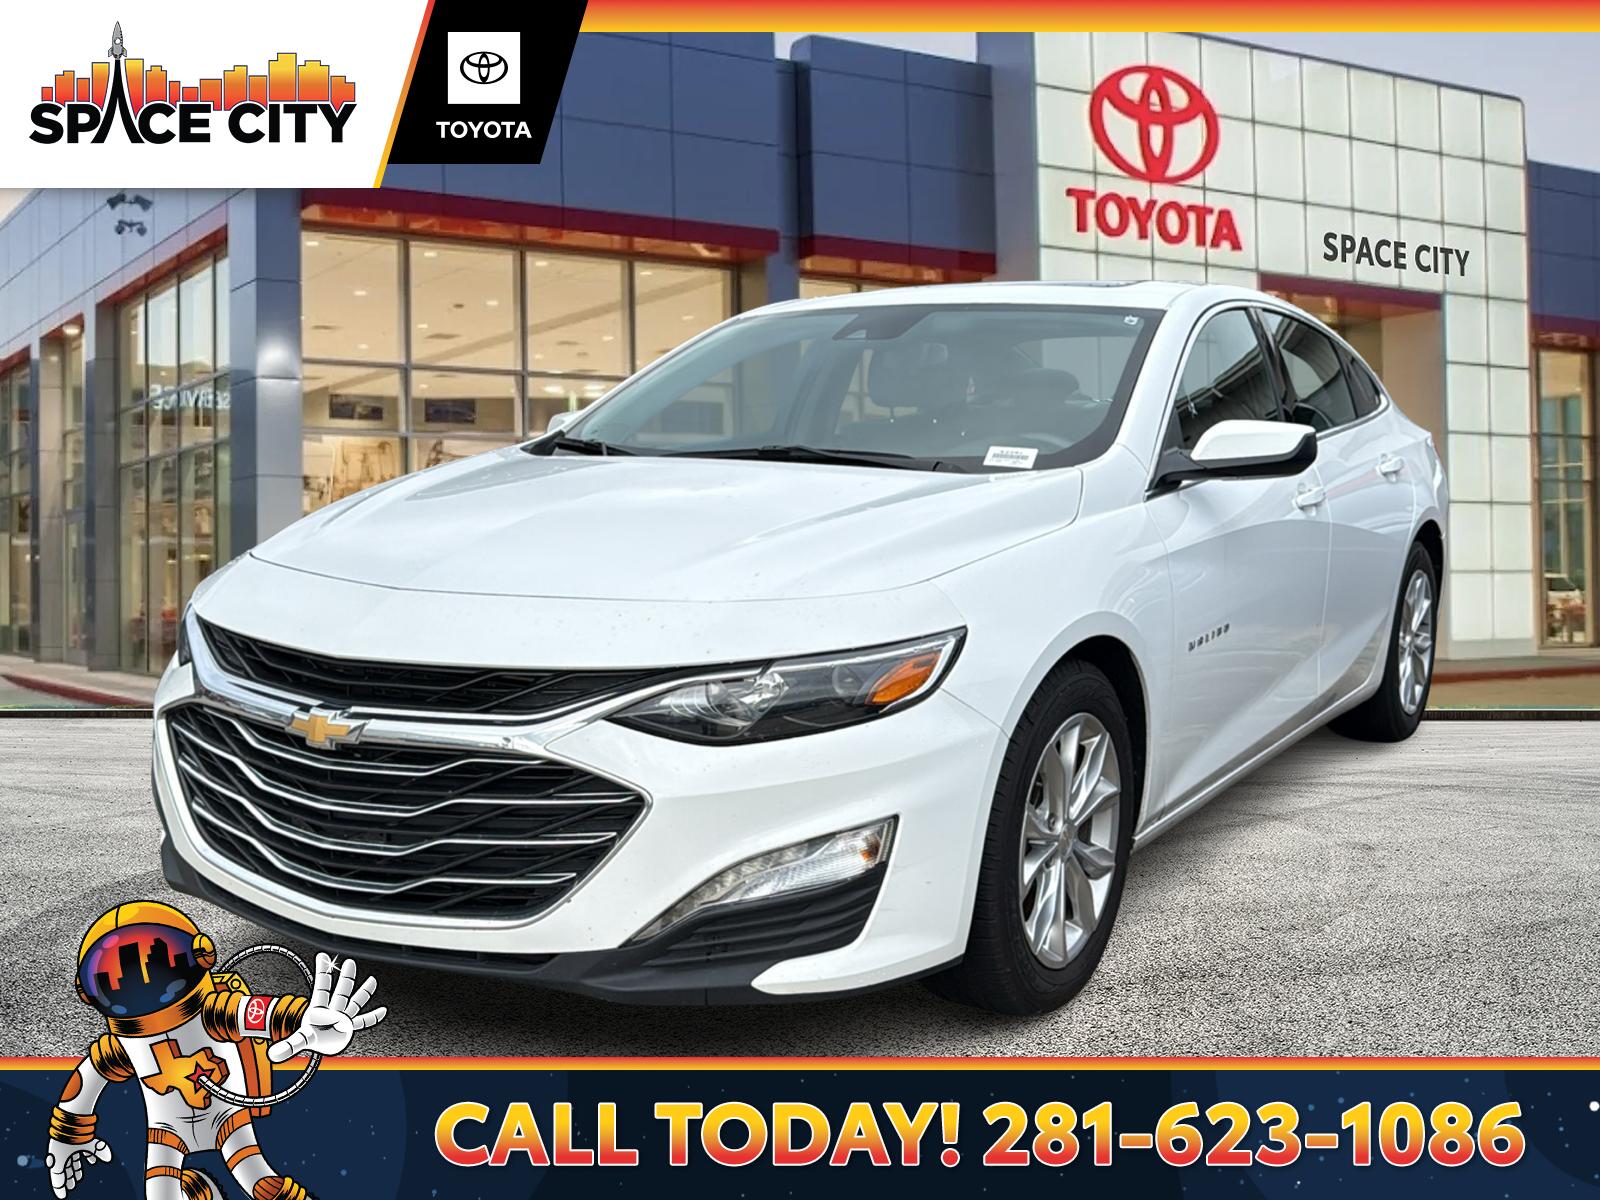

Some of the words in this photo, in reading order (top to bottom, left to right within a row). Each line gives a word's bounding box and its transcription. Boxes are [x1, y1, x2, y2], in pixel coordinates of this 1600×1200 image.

[1066, 188, 1243, 252] TOYOTA
[1323, 231, 1406, 270] SPACE
[1415, 244, 1470, 277] CITY
